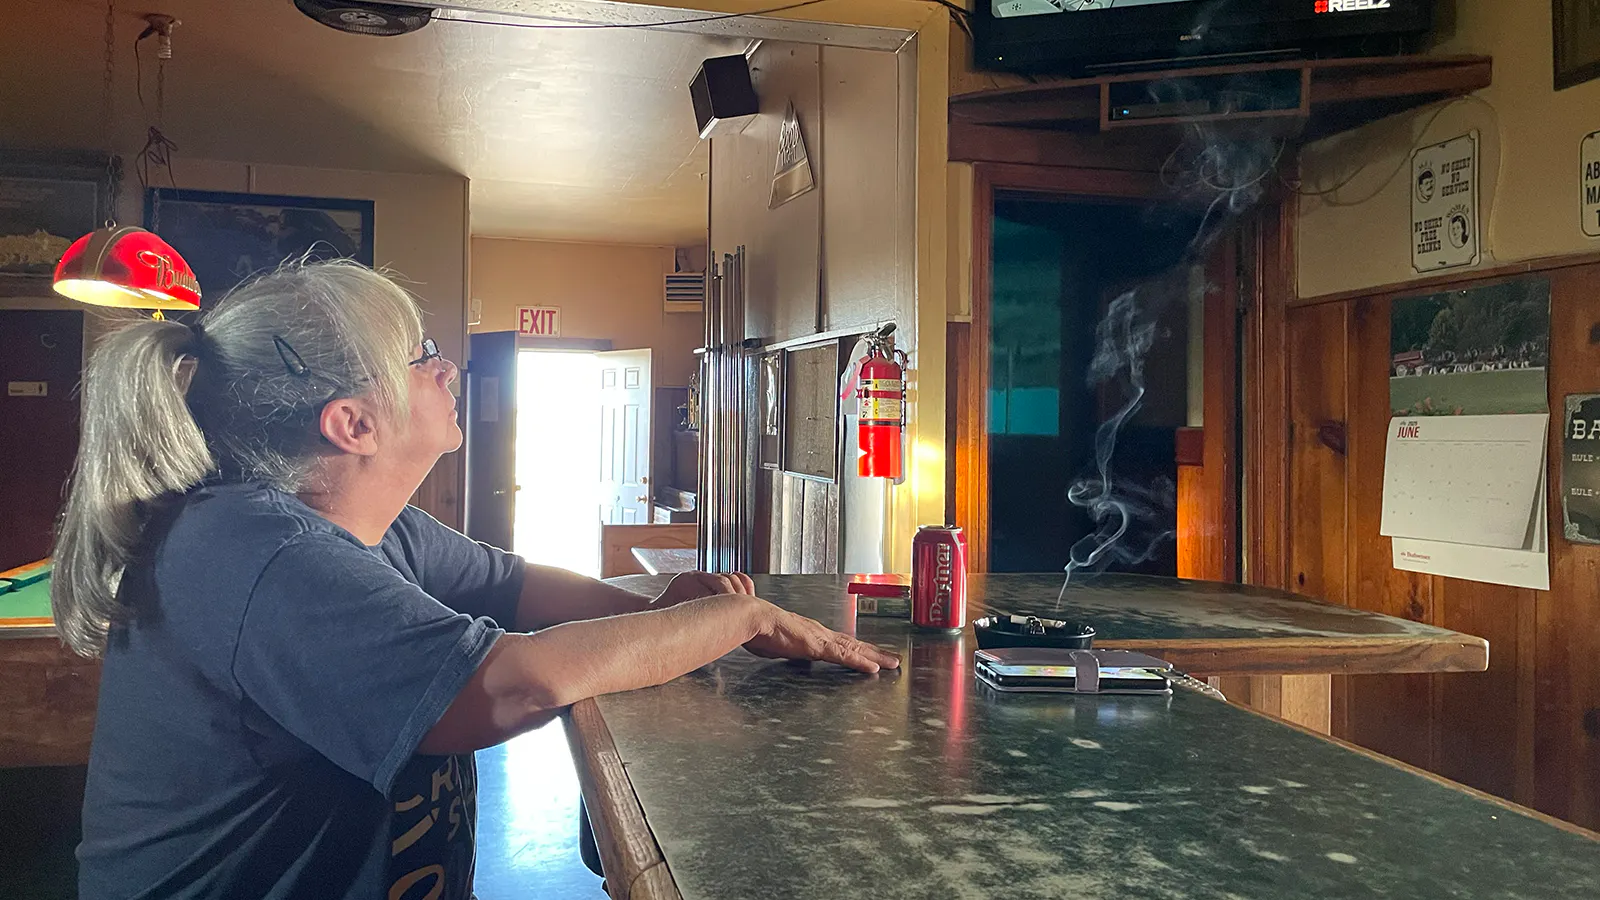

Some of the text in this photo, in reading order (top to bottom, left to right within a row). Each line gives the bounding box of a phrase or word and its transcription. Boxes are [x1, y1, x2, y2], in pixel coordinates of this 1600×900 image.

[1328, 0, 1391, 13] REELZ
[1451, 171, 1460, 183] NO
[1442, 180, 1469, 197] SERVICE
[1414, 221, 1423, 233] NO
[1420, 229, 1437, 243] FREE
[1417, 240, 1442, 254] DRINKS
[519, 308, 557, 335] EXIT
[1397, 426, 1420, 438] JUNE
[1571, 453, 1594, 462] RULE
[1571, 488, 1593, 497] RULE
